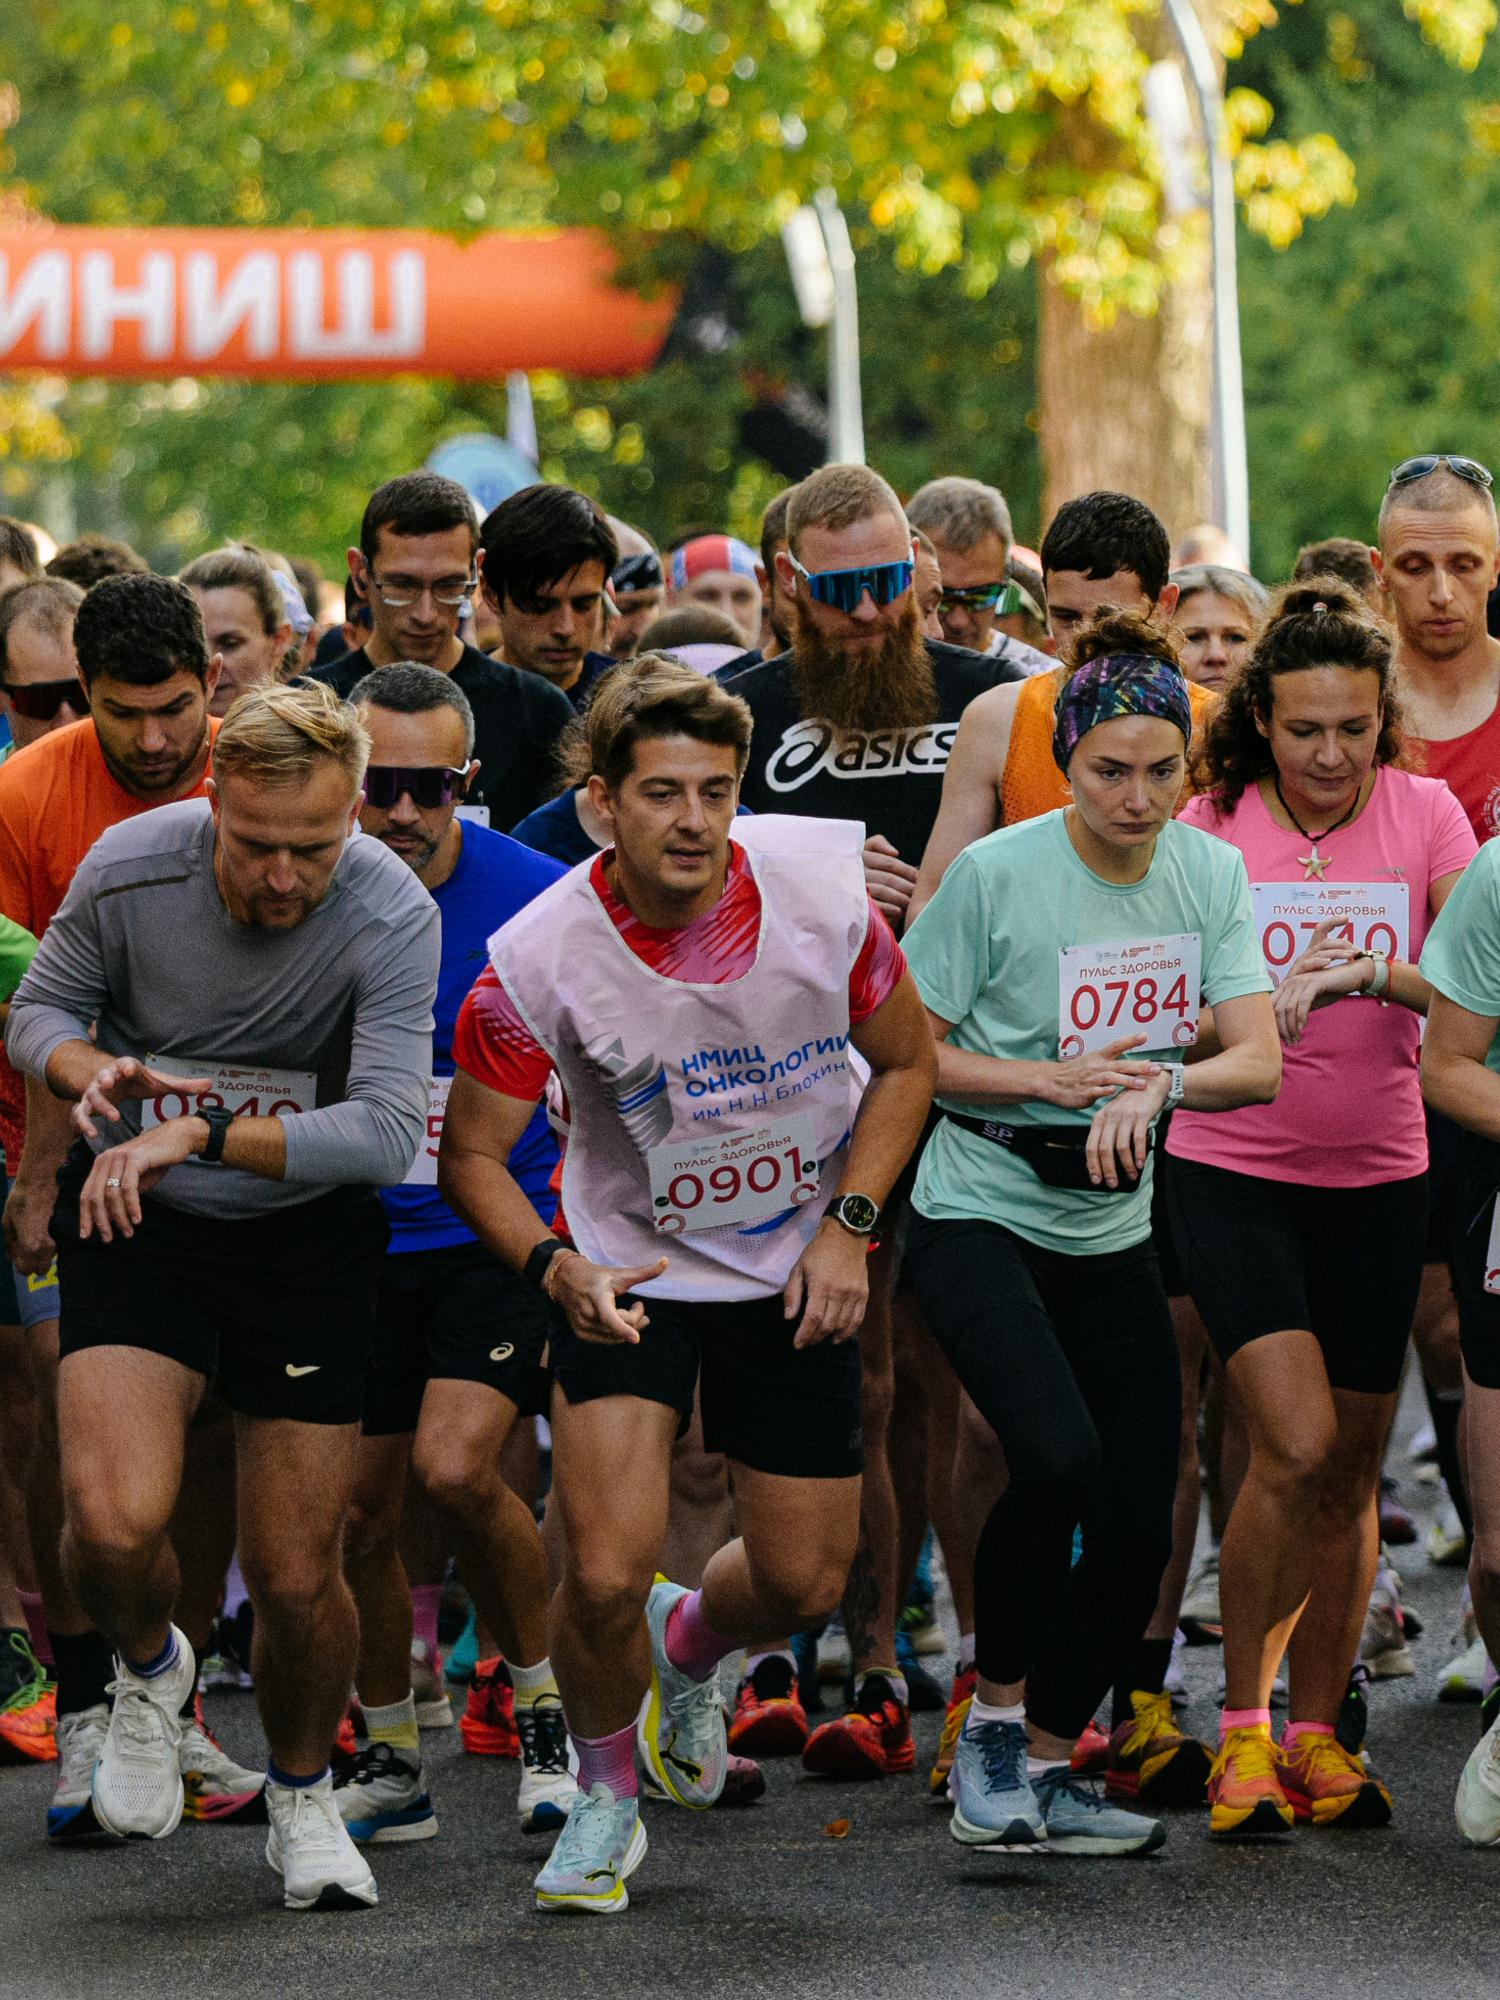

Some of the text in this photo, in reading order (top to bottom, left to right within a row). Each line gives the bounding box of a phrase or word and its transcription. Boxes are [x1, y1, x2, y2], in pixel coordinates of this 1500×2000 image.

[1273, 905, 1385, 916] ПУЛЬС ЗДОРОВЬЯ
[1080, 958, 1181, 979] ПУЛЬС ЗДОРОВЬЯ
[1070, 973, 1190, 1030] 0784
[681, 1044, 766, 1076] НМИЦ
[217, 1080, 291, 1096] ЗДОРОВЬЯ
[776, 1061, 849, 1100] Блохин
[673, 1155, 717, 1171] ПУЛЬС
[720, 1135, 791, 1161] ЗДОРОВЬЯ
[668, 1146, 801, 1209] 0901
